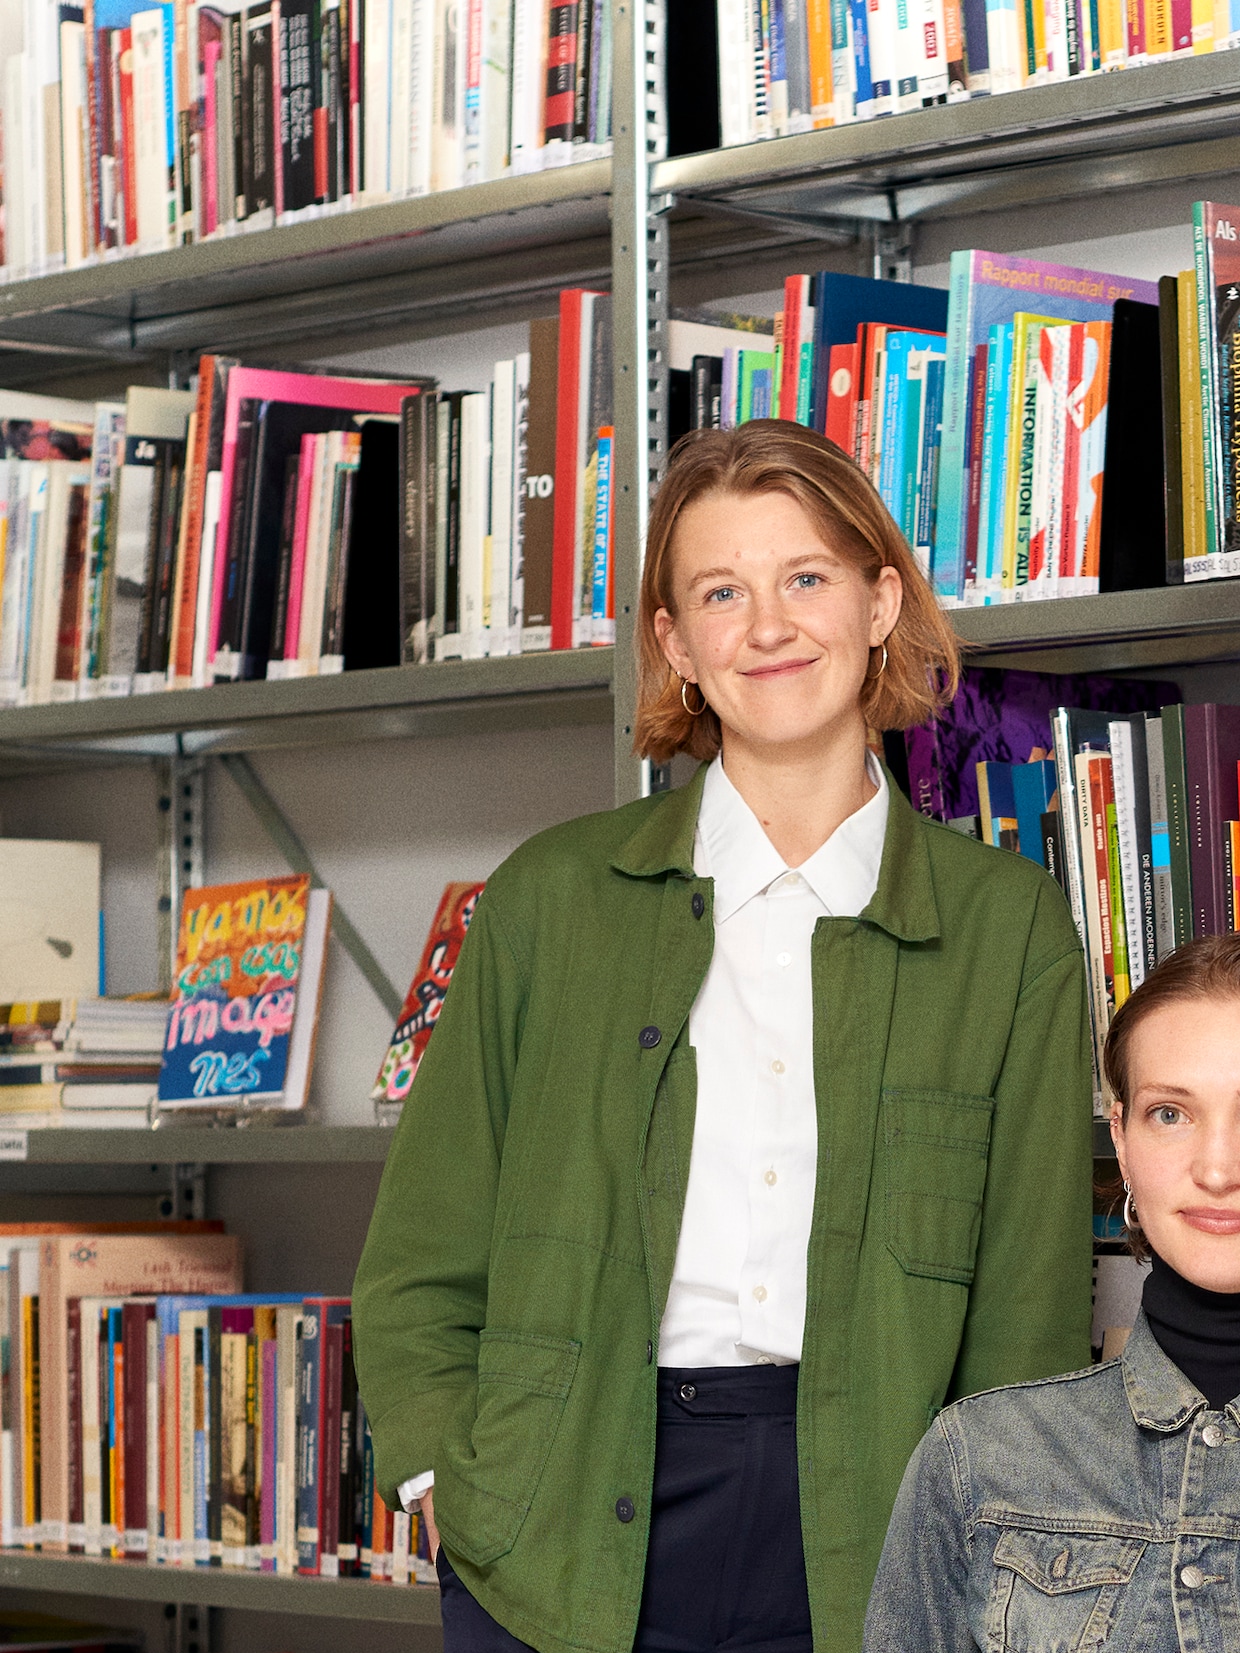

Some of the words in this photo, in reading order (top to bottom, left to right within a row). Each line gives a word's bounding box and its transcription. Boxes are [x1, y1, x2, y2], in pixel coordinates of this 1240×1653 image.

[1194, 226, 1203, 242] ALS
[1214, 219, 1237, 241] Als
[1195, 242, 1203, 253] DE
[982, 259, 1041, 289] Rapport
[1044, 275, 1104, 298] mondial
[1107, 286, 1135, 301] sur
[1196, 255, 1206, 302] NOORDPOOL
[1198, 303, 1207, 340] WARMER
[1200, 341, 1208, 370] WORDT
[977, 369, 986, 385] Free
[1201, 384, 1209, 406] Arctic
[949, 391, 960, 433] Rapport
[975, 408, 983, 421] and
[1202, 408, 1211, 439] Climate
[974, 423, 983, 456] Culture
[1019, 386, 1037, 516] INFORMATION
[1202, 439, 1212, 466] Impact
[598, 454, 609, 479] THE
[1204, 467, 1213, 512] Assessment
[596, 484, 608, 528] STATE
[595, 533, 606, 548] OF
[1017, 527, 1029, 543] IS
[594, 553, 606, 586] PLAY
[1080, 778, 1089, 803] DIRTY
[1081, 805, 1090, 828] DATA
[1142, 853, 1151, 868] DIE
[1099, 878, 1110, 916] Mestizos
[1143, 870, 1153, 914] ANDEREN
[1159, 875, 1168, 910] mirror's
[1101, 916, 1112, 955] Espacios
[1159, 912, 1169, 935] edge
[1145, 916, 1156, 971] MODERNEN
